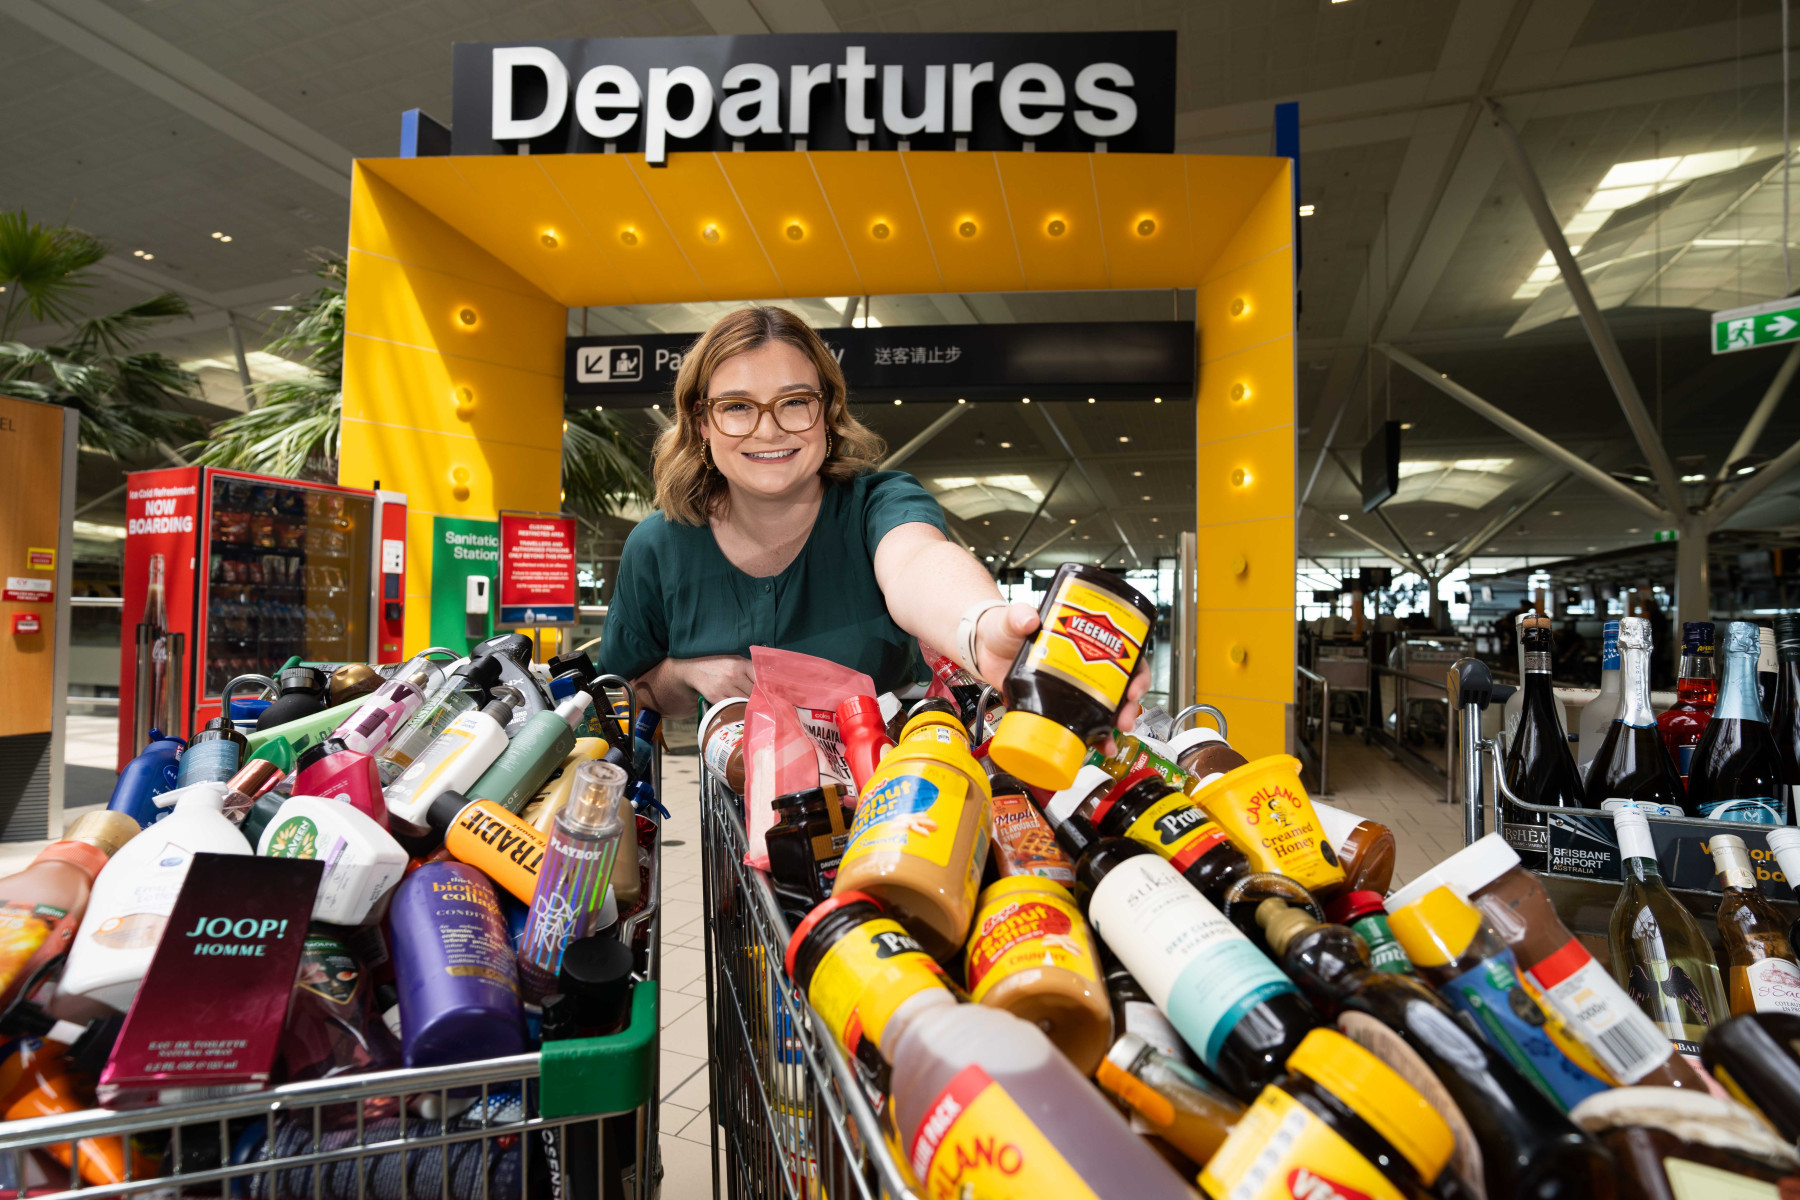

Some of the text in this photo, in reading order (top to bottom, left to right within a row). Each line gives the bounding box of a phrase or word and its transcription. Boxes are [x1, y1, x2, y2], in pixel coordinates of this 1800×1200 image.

[491, 45, 1139, 165] Departures
[874, 346, 962, 366] 送客请止步
[129, 485, 196, 499] Ice Cold Refreshment
[145, 499, 177, 516] NOW
[129, 515, 193, 535] BOARDING
[453, 547, 499, 561] Station
[1071, 615, 1123, 653] VEGEMITE
[1246, 785, 1302, 826] CAPILANO
[994, 808, 1040, 826] Maple
[1161, 808, 1209, 836] Prom
[1000, 820, 1041, 837] FLAVOURED
[1261, 822, 1314, 849] Creamed
[460, 807, 544, 876] TRADIE
[550, 836, 602, 861] PLAYBOY
[1274, 836, 1315, 858] Honey
[1553, 847, 1611, 861] BRISBANE
[1553, 857, 1603, 869] AIRPORT
[1553, 865, 1594, 874] AUSTRALIA
[432, 882, 489, 900] biotin
[185, 916, 289, 940] JOOP!
[972, 904, 1049, 967] Peanut
[193, 943, 267, 957] HOMME
[984, 920, 1041, 959] Butter
[923, 1092, 962, 1147] PACK
